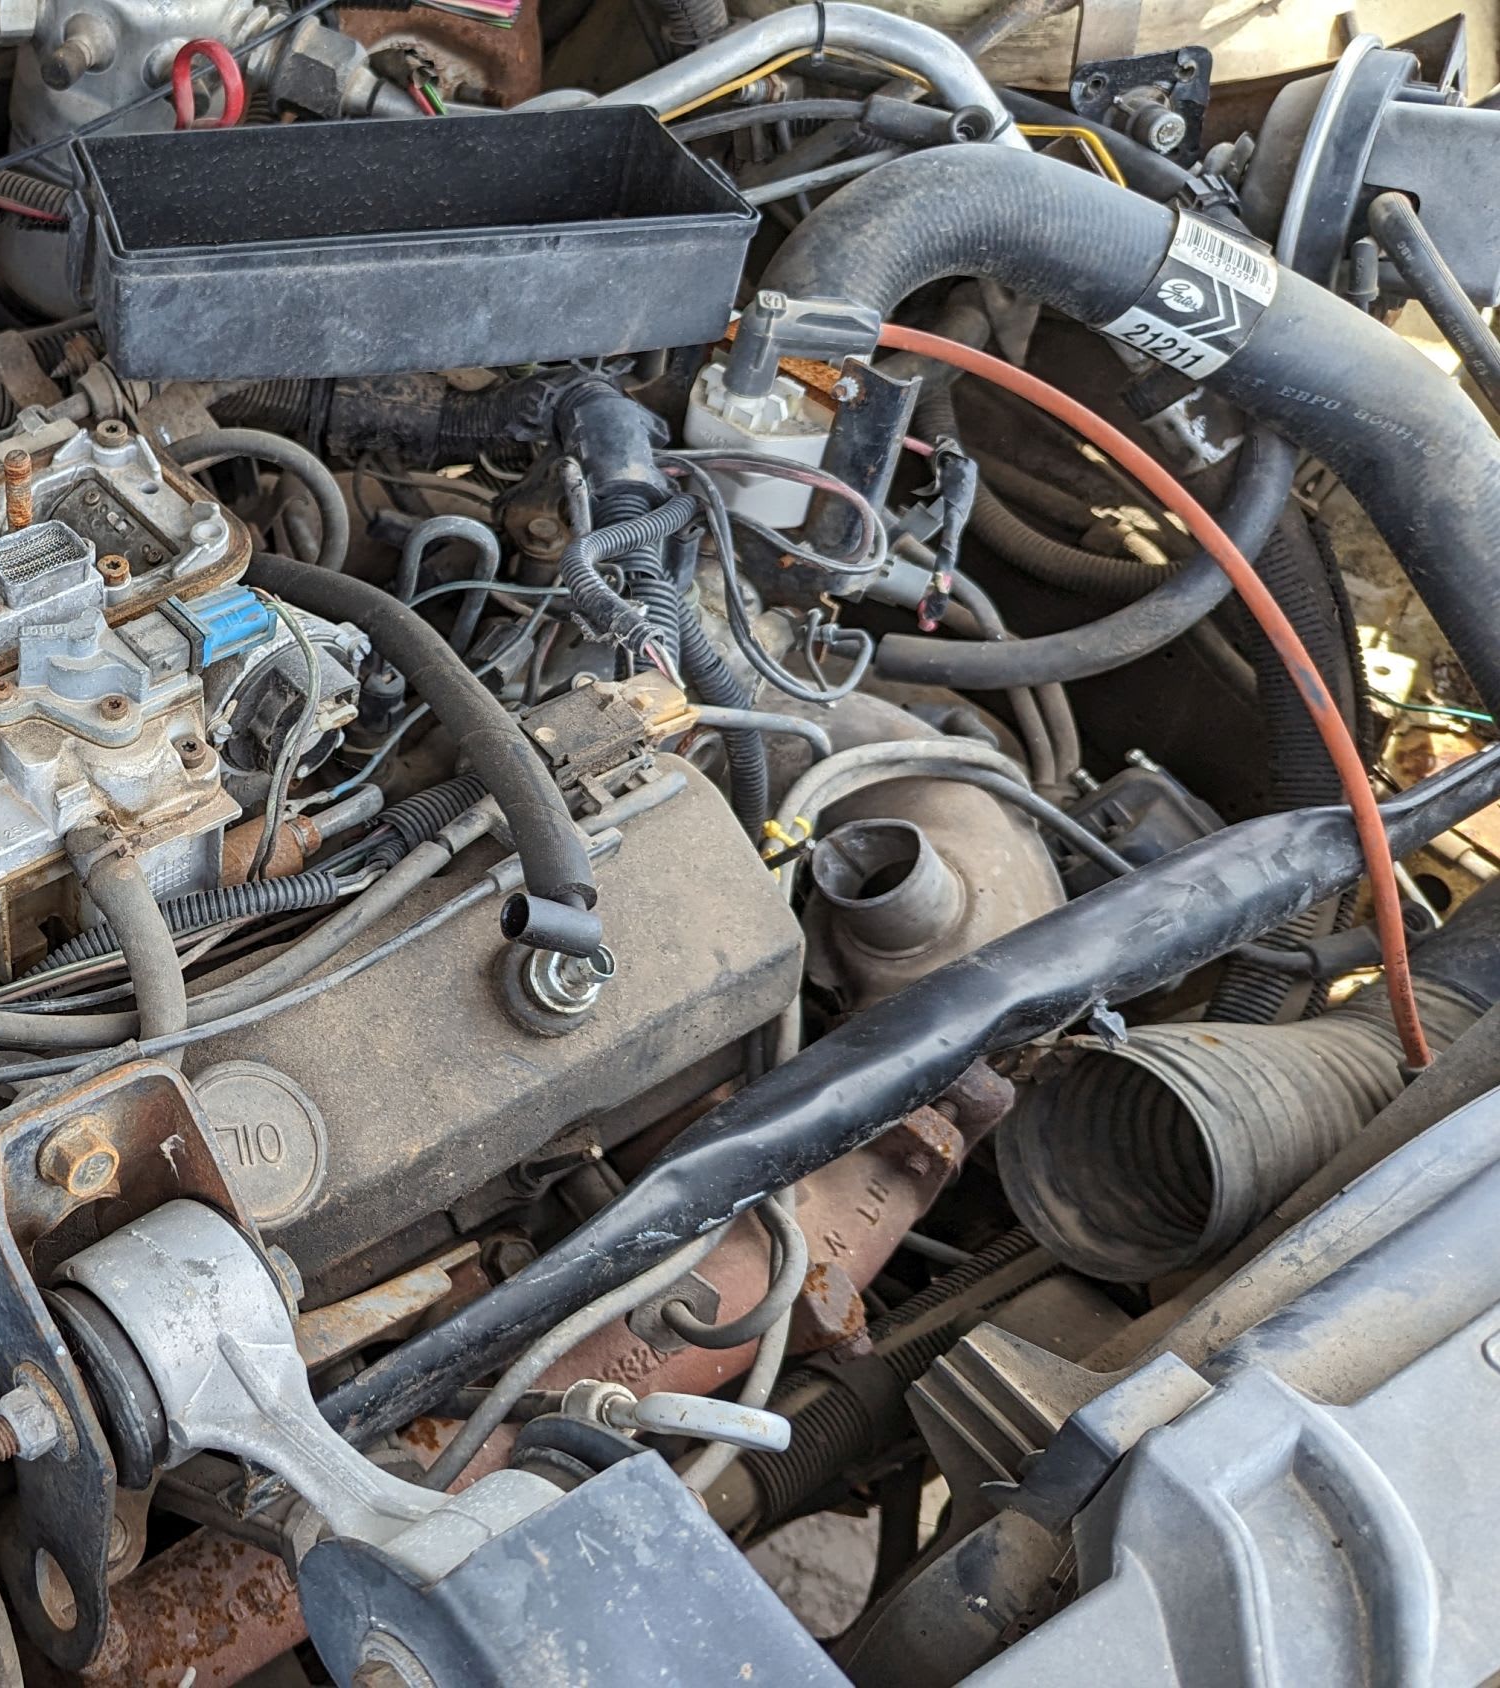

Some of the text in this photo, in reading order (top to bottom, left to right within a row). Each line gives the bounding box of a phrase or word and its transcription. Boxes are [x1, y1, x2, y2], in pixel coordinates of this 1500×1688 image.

[1173, 237, 1181, 246] 0
[1191, 247, 1221, 267] 72053
[1224, 264, 1256, 284] 05599
[1157, 283, 1201, 312] Gates
[1121, 323, 1205, 370] 21211
